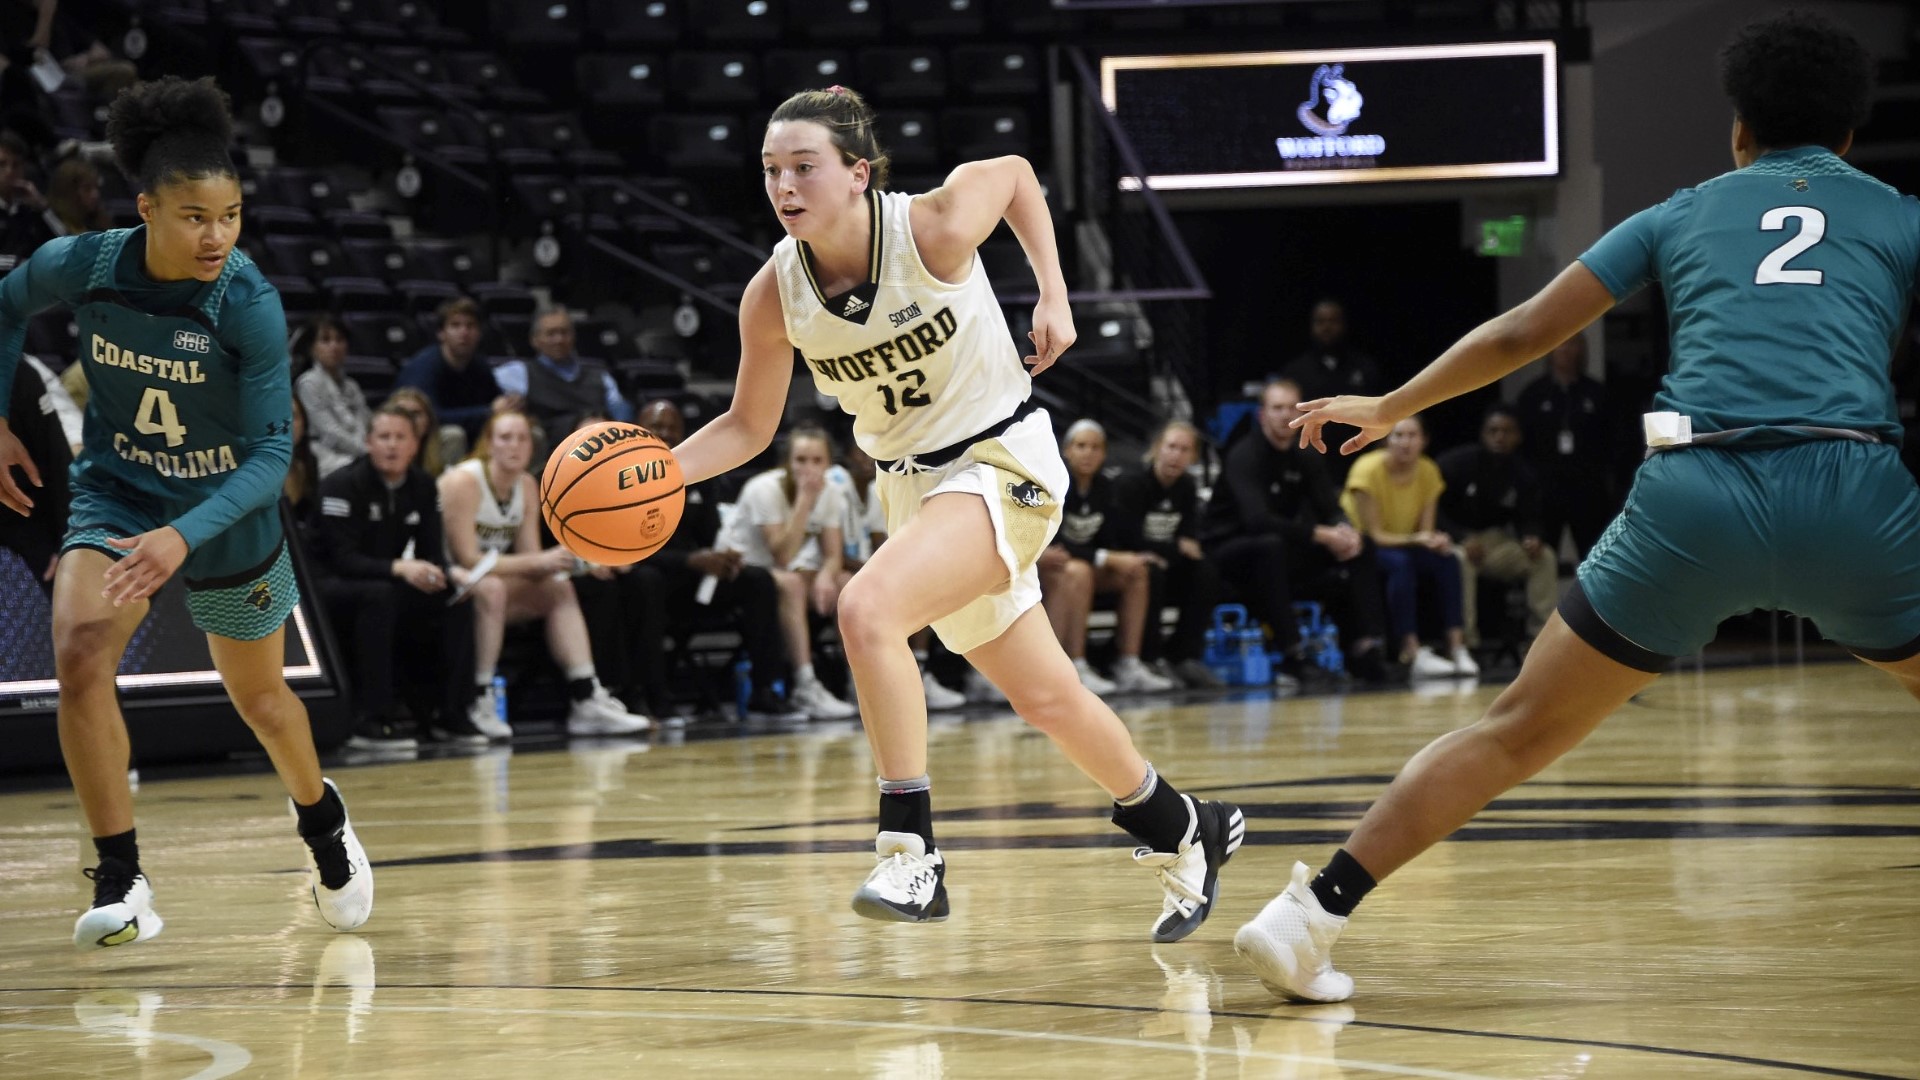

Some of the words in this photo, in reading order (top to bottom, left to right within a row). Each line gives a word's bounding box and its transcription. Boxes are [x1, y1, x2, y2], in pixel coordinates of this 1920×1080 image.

[1755, 206, 1826, 285] 2
[843, 302, 869, 316] adidas
[888, 301, 922, 328] SOCON
[92, 333, 206, 383] COASTAL
[173, 330, 210, 353] SBC
[809, 306, 957, 382] WOFFORD
[877, 368, 931, 415] 12
[133, 387, 187, 448] 4
